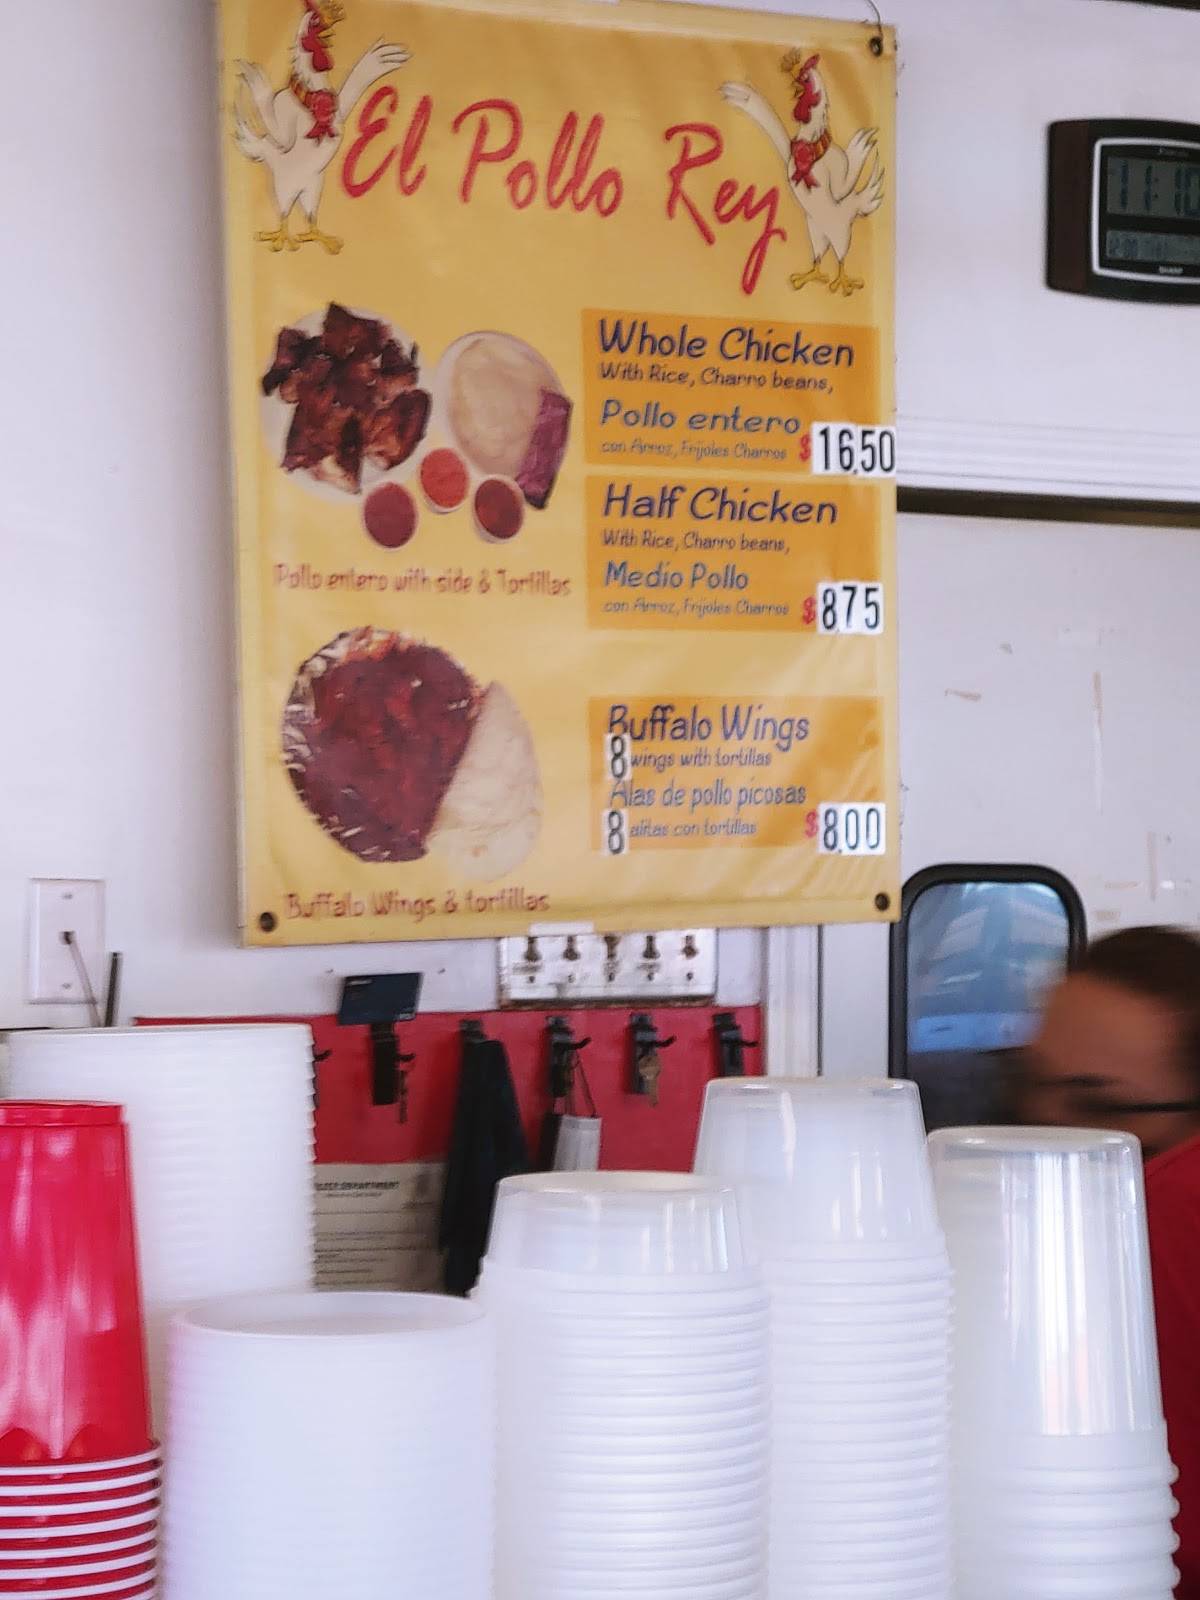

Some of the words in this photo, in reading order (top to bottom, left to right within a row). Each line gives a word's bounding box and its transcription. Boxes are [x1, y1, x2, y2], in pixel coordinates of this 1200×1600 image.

[341, 84, 434, 198] El
[452, 98, 623, 219] Pollo
[664, 121, 787, 295] Rey
[599, 318, 707, 359] Whole
[720, 327, 855, 368] Chicken
[600, 362, 644, 383] With
[650, 364, 696, 388] Rice,
[700, 367, 767, 388] Charro
[772, 369, 833, 394] beans,
[601, 398, 676, 429] Pollo
[688, 406, 800, 435] entero
[602, 441, 626, 454] con
[734, 442, 787, 460] Charros
[603, 483, 687, 519] Half
[690, 486, 838, 525] Chicken
[602, 530, 637, 548] With
[641, 531, 678, 552] Rice,
[683, 531, 736, 551] Charro
[740, 532, 789, 555] beans,
[273, 562, 322, 590] Pollo
[326, 568, 388, 592] entero
[393, 567, 431, 592] with
[437, 568, 472, 593] side
[496, 568, 571, 596] Tortillas
[604, 560, 683, 588] Medio
[690, 561, 748, 590] Pollo
[604, 601, 629, 614] con
[736, 599, 790, 616] Charros
[608, 704, 712, 742] Buffalo
[721, 703, 809, 752] Wings
[609, 735, 627, 779] 8
[630, 751, 675, 773] wings
[680, 748, 711, 766] with
[715, 748, 772, 767] tortillas
[609, 778, 655, 807] Alas
[662, 778, 685, 807] de
[691, 777, 733, 814] pollo
[737, 777, 806, 814] picosas
[608, 810, 625, 855] 8
[673, 822, 699, 837] con
[704, 819, 757, 836] tortillas
[284, 892, 365, 919] Buffalo
[371, 889, 435, 924] Wings
[465, 887, 550, 913] tortillas
